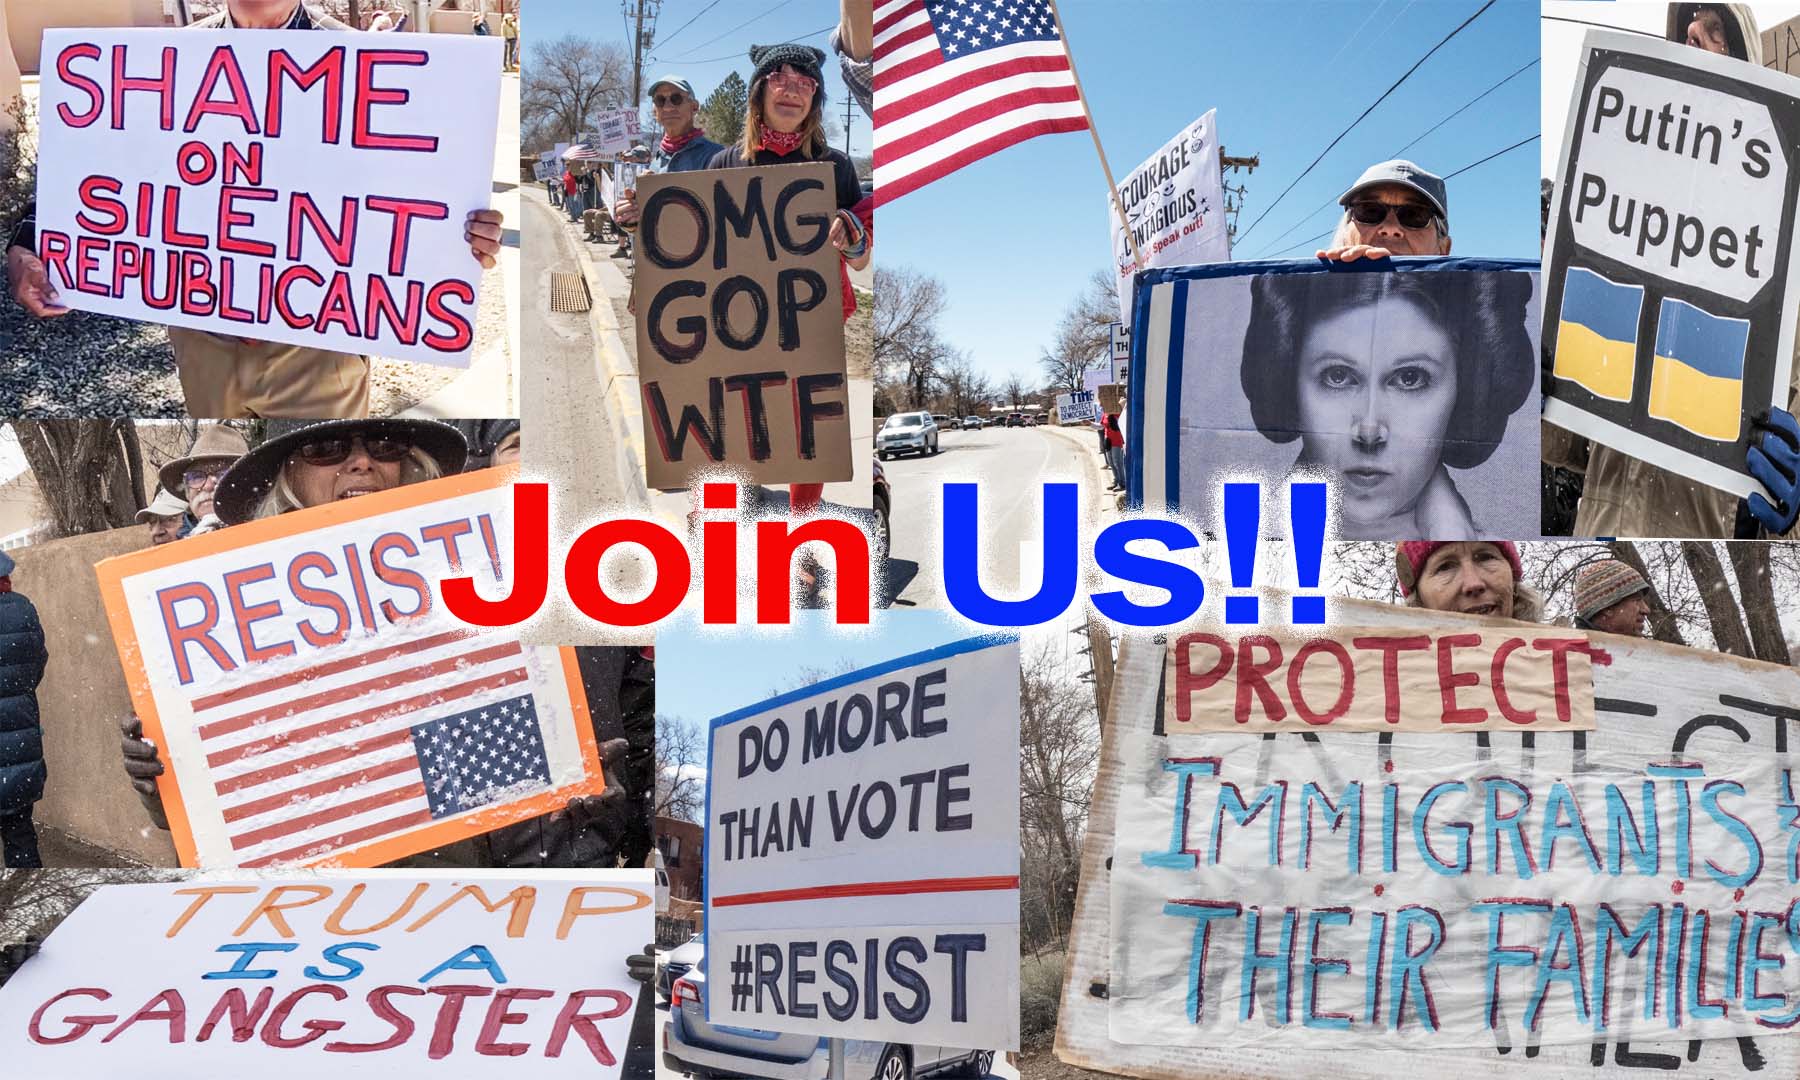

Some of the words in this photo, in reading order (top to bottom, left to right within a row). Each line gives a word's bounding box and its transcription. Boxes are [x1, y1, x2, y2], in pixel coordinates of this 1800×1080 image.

[56, 42, 439, 152] SHAME
[1592, 86, 1771, 178] Putin's
[176, 141, 263, 186] ON
[1121, 138, 1191, 213] COURAGE
[76, 174, 449, 277] SILENT
[641, 176, 830, 270] OMG
[1183, 215, 1203, 236] out!
[1575, 172, 1763, 278] Puppet
[40, 230, 475, 352] REPUBLICANS
[648, 268, 827, 364] GOP
[644, 371, 844, 463] WTF
[1068, 401, 1091, 411] PROTECT
[738, 718, 789, 779] DO
[802, 668, 948, 764] MORE
[1175, 632, 1612, 725] PROTECT
[719, 795, 814, 861] THAN
[828, 763, 973, 842] VOTE
[166, 882, 653, 940] TRUMP
[202, 941, 381, 981] IS
[419, 944, 507, 983] A
[731, 933, 987, 1023] #RESIST
[28, 984, 633, 1066] GANGSTER
